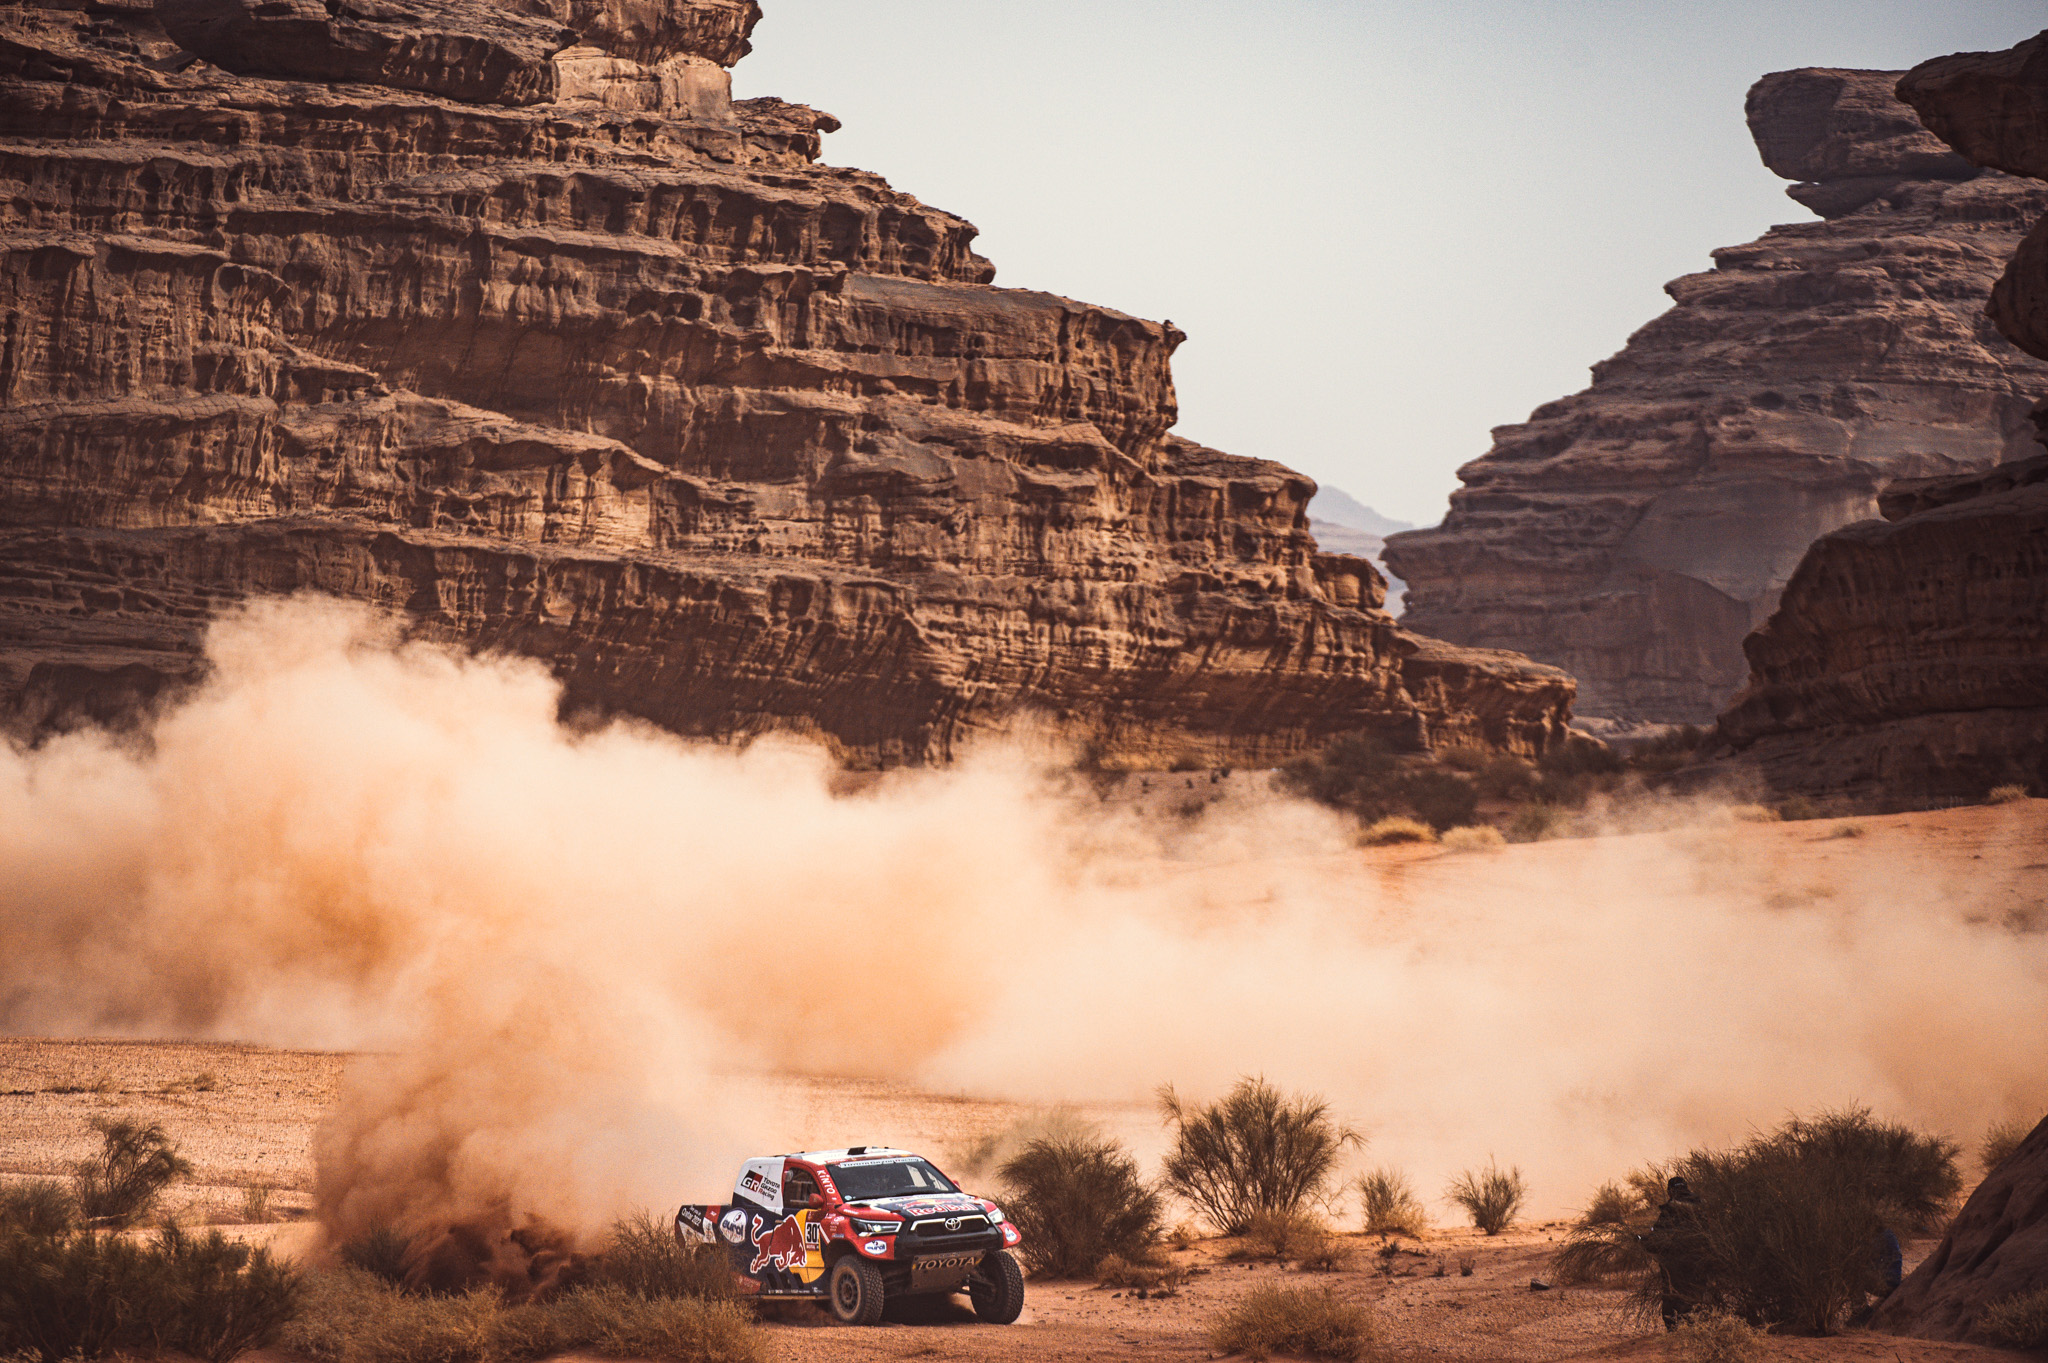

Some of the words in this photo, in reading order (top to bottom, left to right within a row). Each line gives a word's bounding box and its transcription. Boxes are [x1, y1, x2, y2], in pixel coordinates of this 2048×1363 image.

[742, 1177, 760, 1192] GR
[907, 1204, 948, 1216] Red
[944, 1203, 979, 1211] Bull
[722, 1219, 743, 1237] eurol
[918, 1256, 976, 1271] TOYOTA
